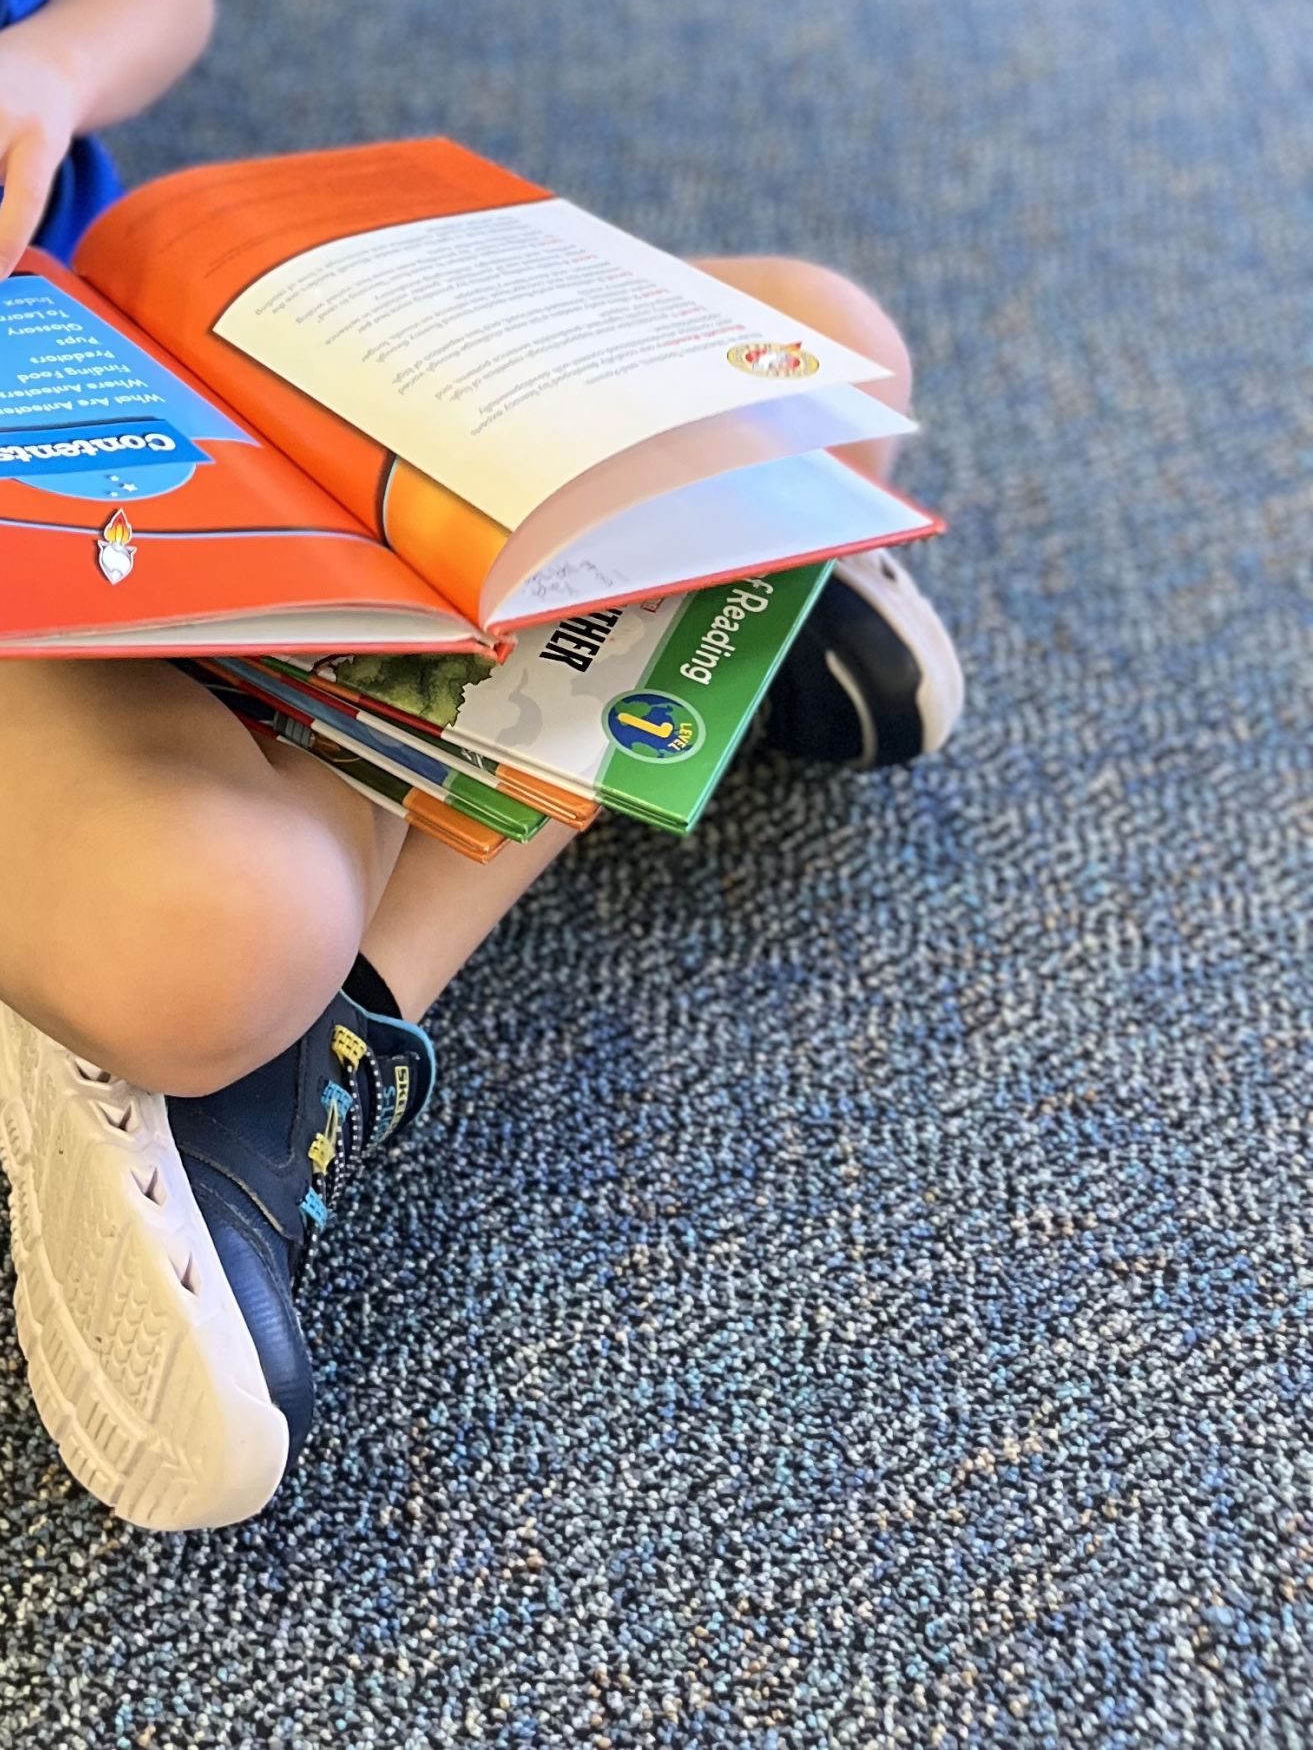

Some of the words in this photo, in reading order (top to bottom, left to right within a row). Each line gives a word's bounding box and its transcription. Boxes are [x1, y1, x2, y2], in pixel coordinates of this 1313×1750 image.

[3, 295, 56, 307] Index
[47, 308, 70, 319] To
[7, 321, 84, 337] Glossary
[55, 335, 101, 346] Pups
[29, 349, 116, 364] Predators
[17, 370, 62, 383] Food
[63, 363, 132, 377] Finding
[86, 378, 149, 391] Where
[77, 396, 110, 407] Are
[114, 393, 166, 405] What
[680, 588, 769, 685] Reading
[617, 712, 674, 739] 1
[667, 722, 693, 752] LEVEL
